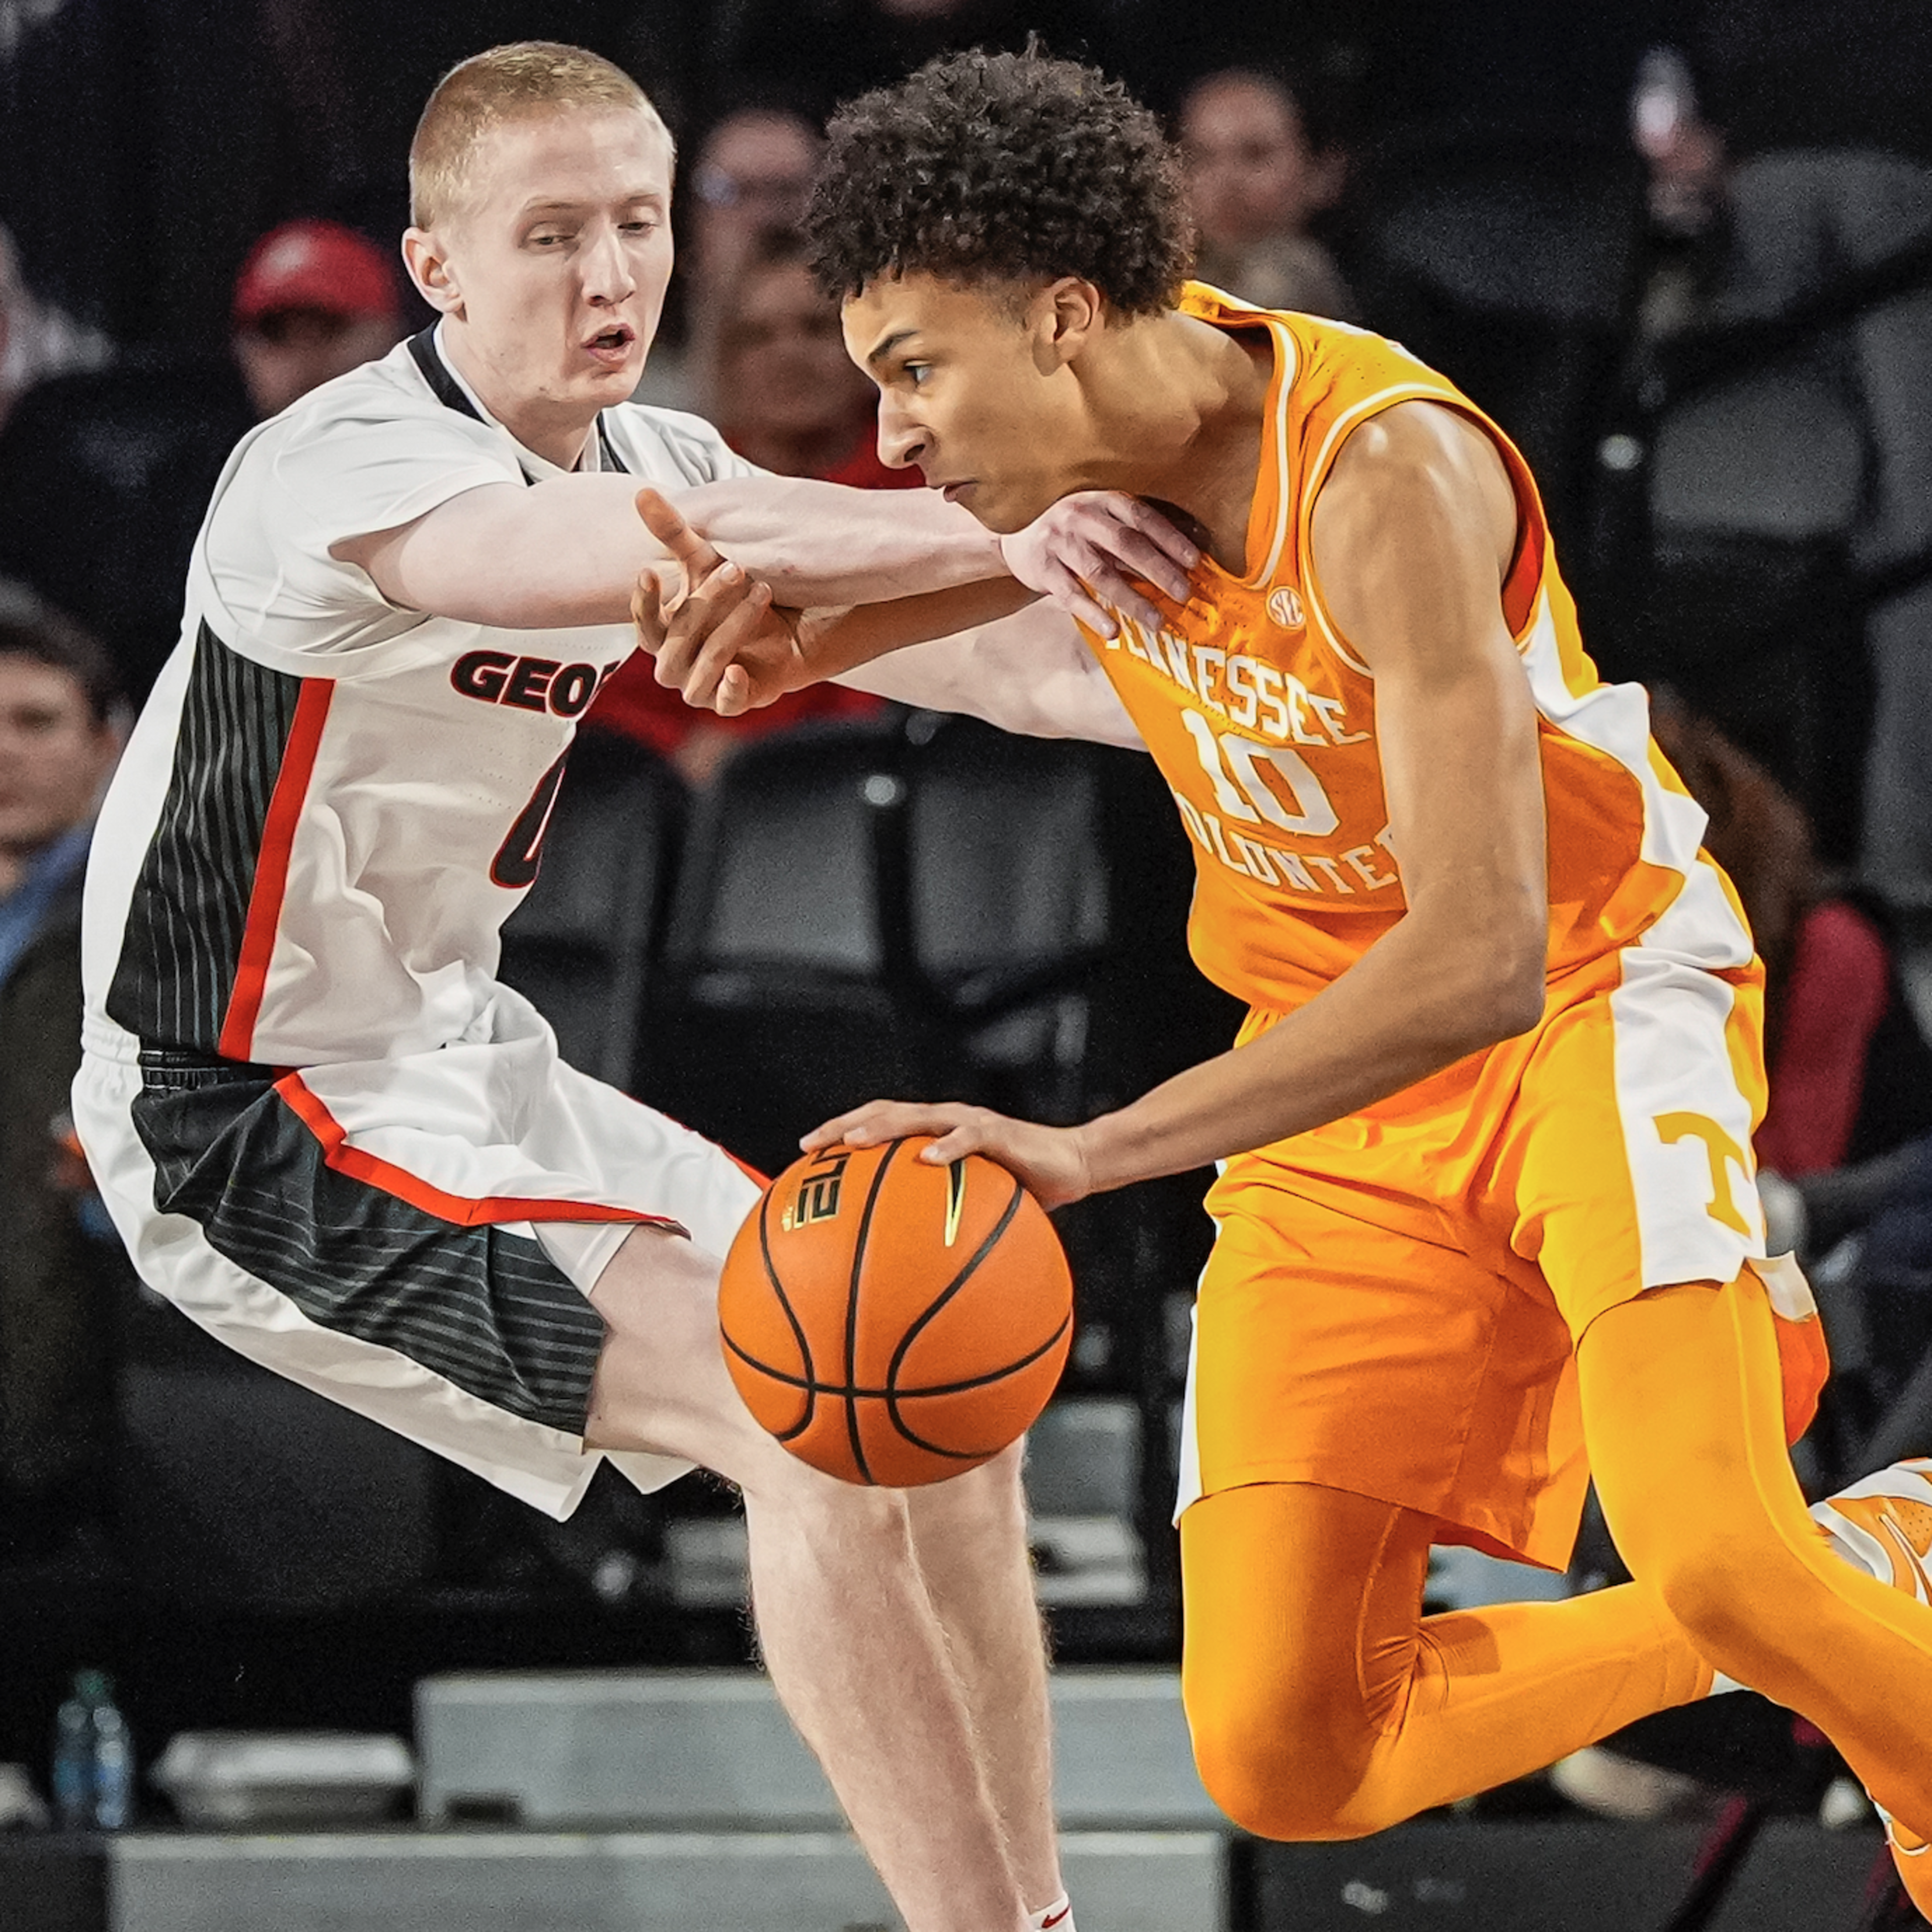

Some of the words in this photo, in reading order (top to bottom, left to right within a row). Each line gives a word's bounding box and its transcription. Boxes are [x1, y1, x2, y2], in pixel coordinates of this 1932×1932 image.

[450, 650, 622, 718] GEO
[1096, 593, 1372, 747] ENNESSEE
[1180, 707, 1341, 837] 10
[1651, 1111, 1752, 1241] T
